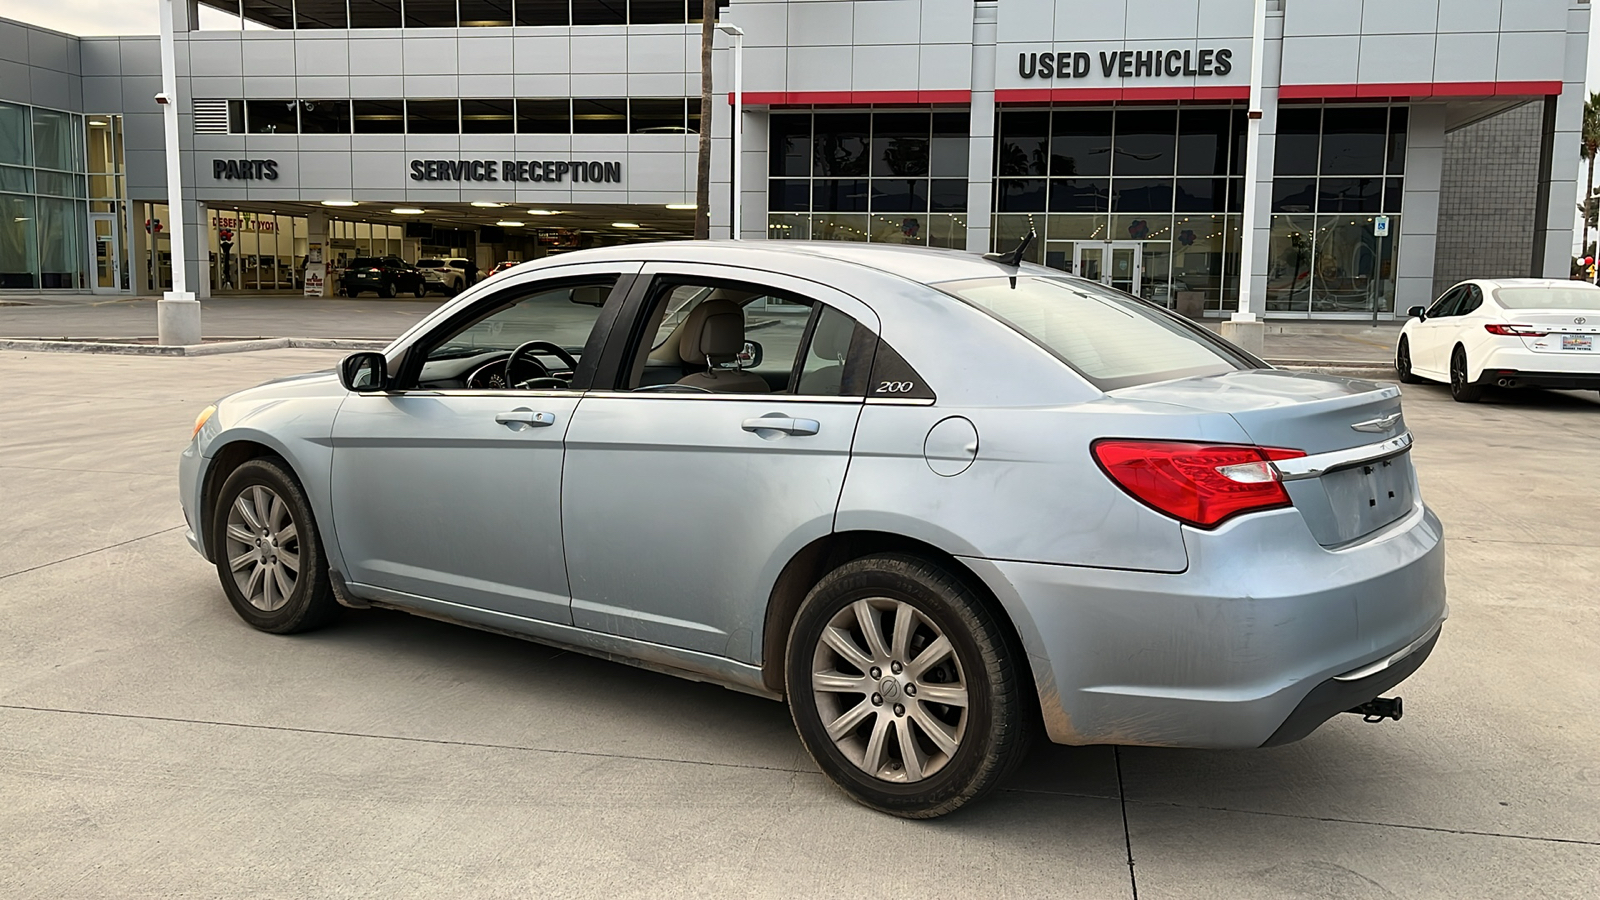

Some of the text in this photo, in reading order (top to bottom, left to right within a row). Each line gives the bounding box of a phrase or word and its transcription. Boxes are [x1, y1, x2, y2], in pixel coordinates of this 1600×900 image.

[1018, 49, 1233, 79] USED VEHICLES
[212, 159, 278, 180] PARTS
[410, 159, 621, 183] SERVICE RECEPTION
[875, 381, 914, 393] 200
